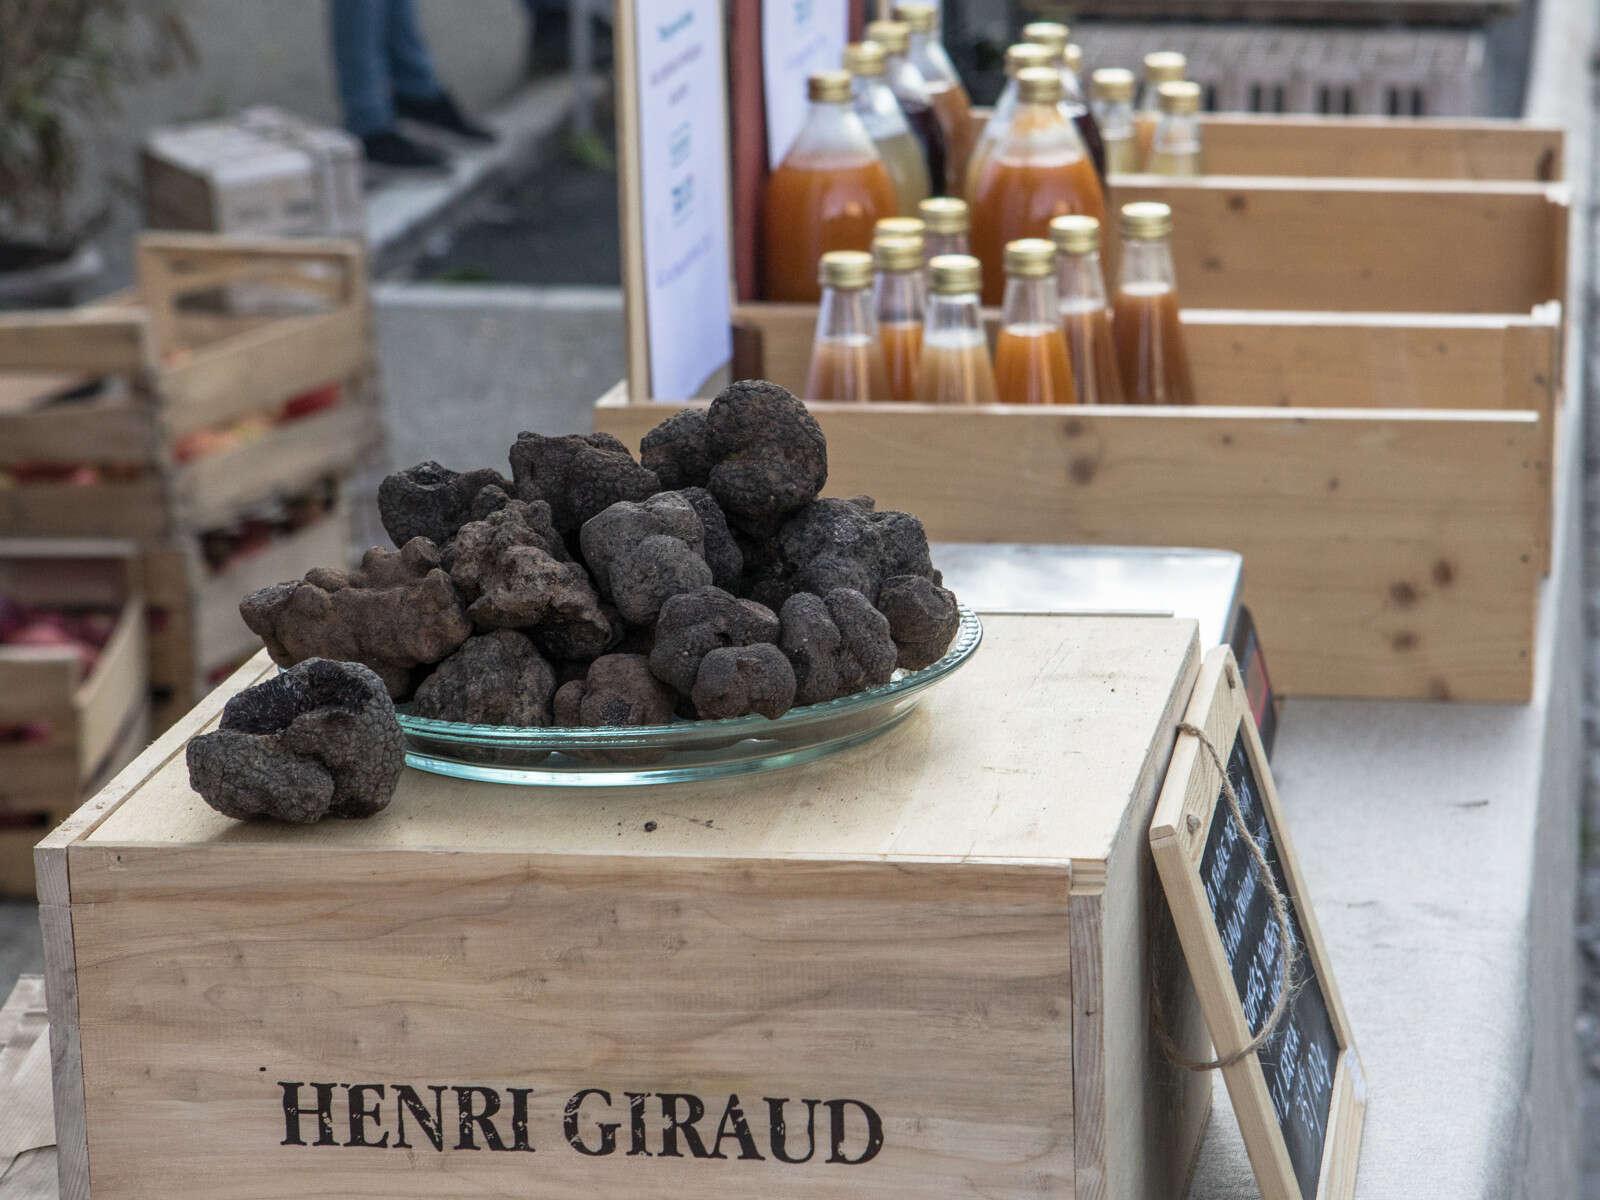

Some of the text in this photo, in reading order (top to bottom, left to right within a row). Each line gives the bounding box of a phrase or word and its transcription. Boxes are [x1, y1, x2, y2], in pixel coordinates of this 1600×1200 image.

[1211, 833, 1231, 903] TABLE
[1243, 954, 1266, 1035] RUFFES
[1280, 1021, 1300, 1091] EXTRA
[277, 1081, 884, 1165] HENRI GIRAUD
